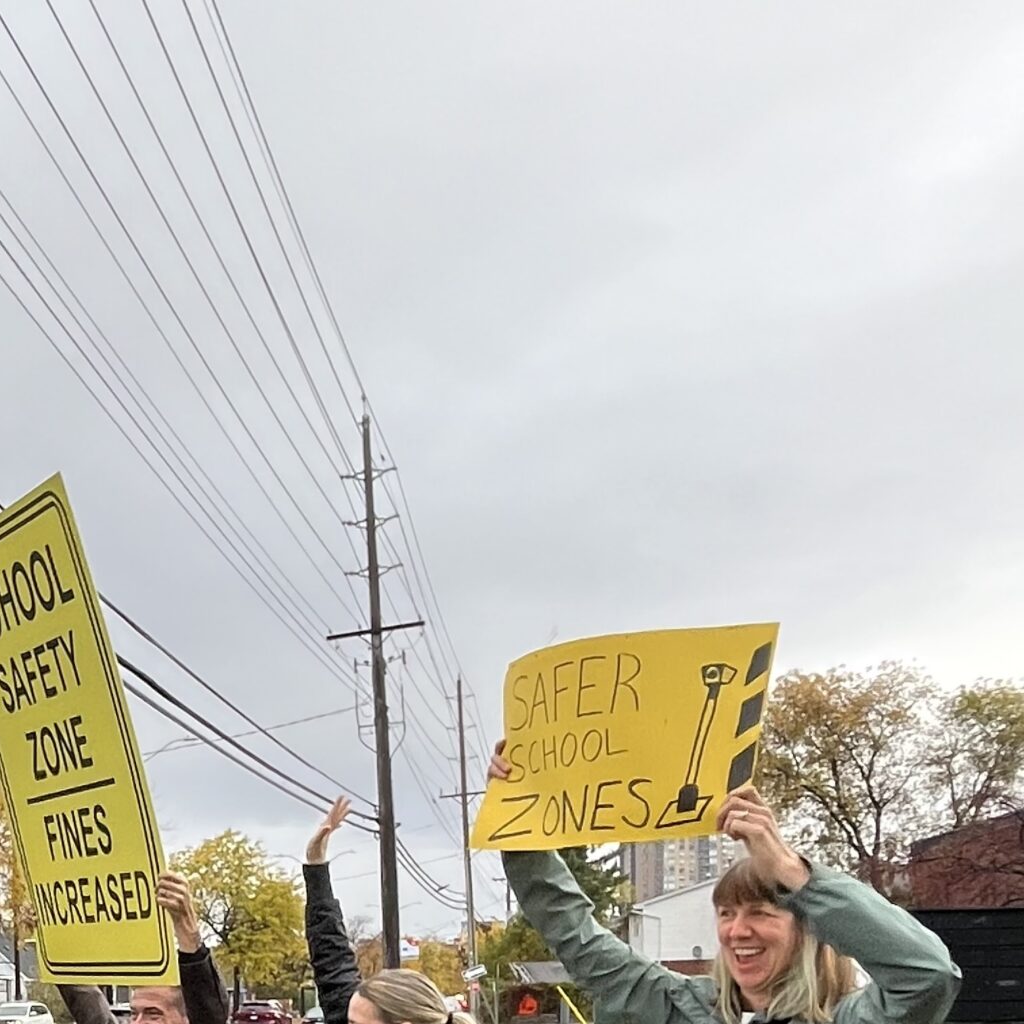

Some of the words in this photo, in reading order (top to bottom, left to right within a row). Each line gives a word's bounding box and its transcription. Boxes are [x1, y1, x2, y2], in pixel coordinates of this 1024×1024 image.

[510, 652, 641, 731] SAFER
[25, 716, 94, 782] ZONE
[506, 728, 628, 783] SCHOOL
[43, 804, 113, 862] FINES
[488, 778, 652, 842] ZONES
[35, 870, 152, 927] INCREASED
